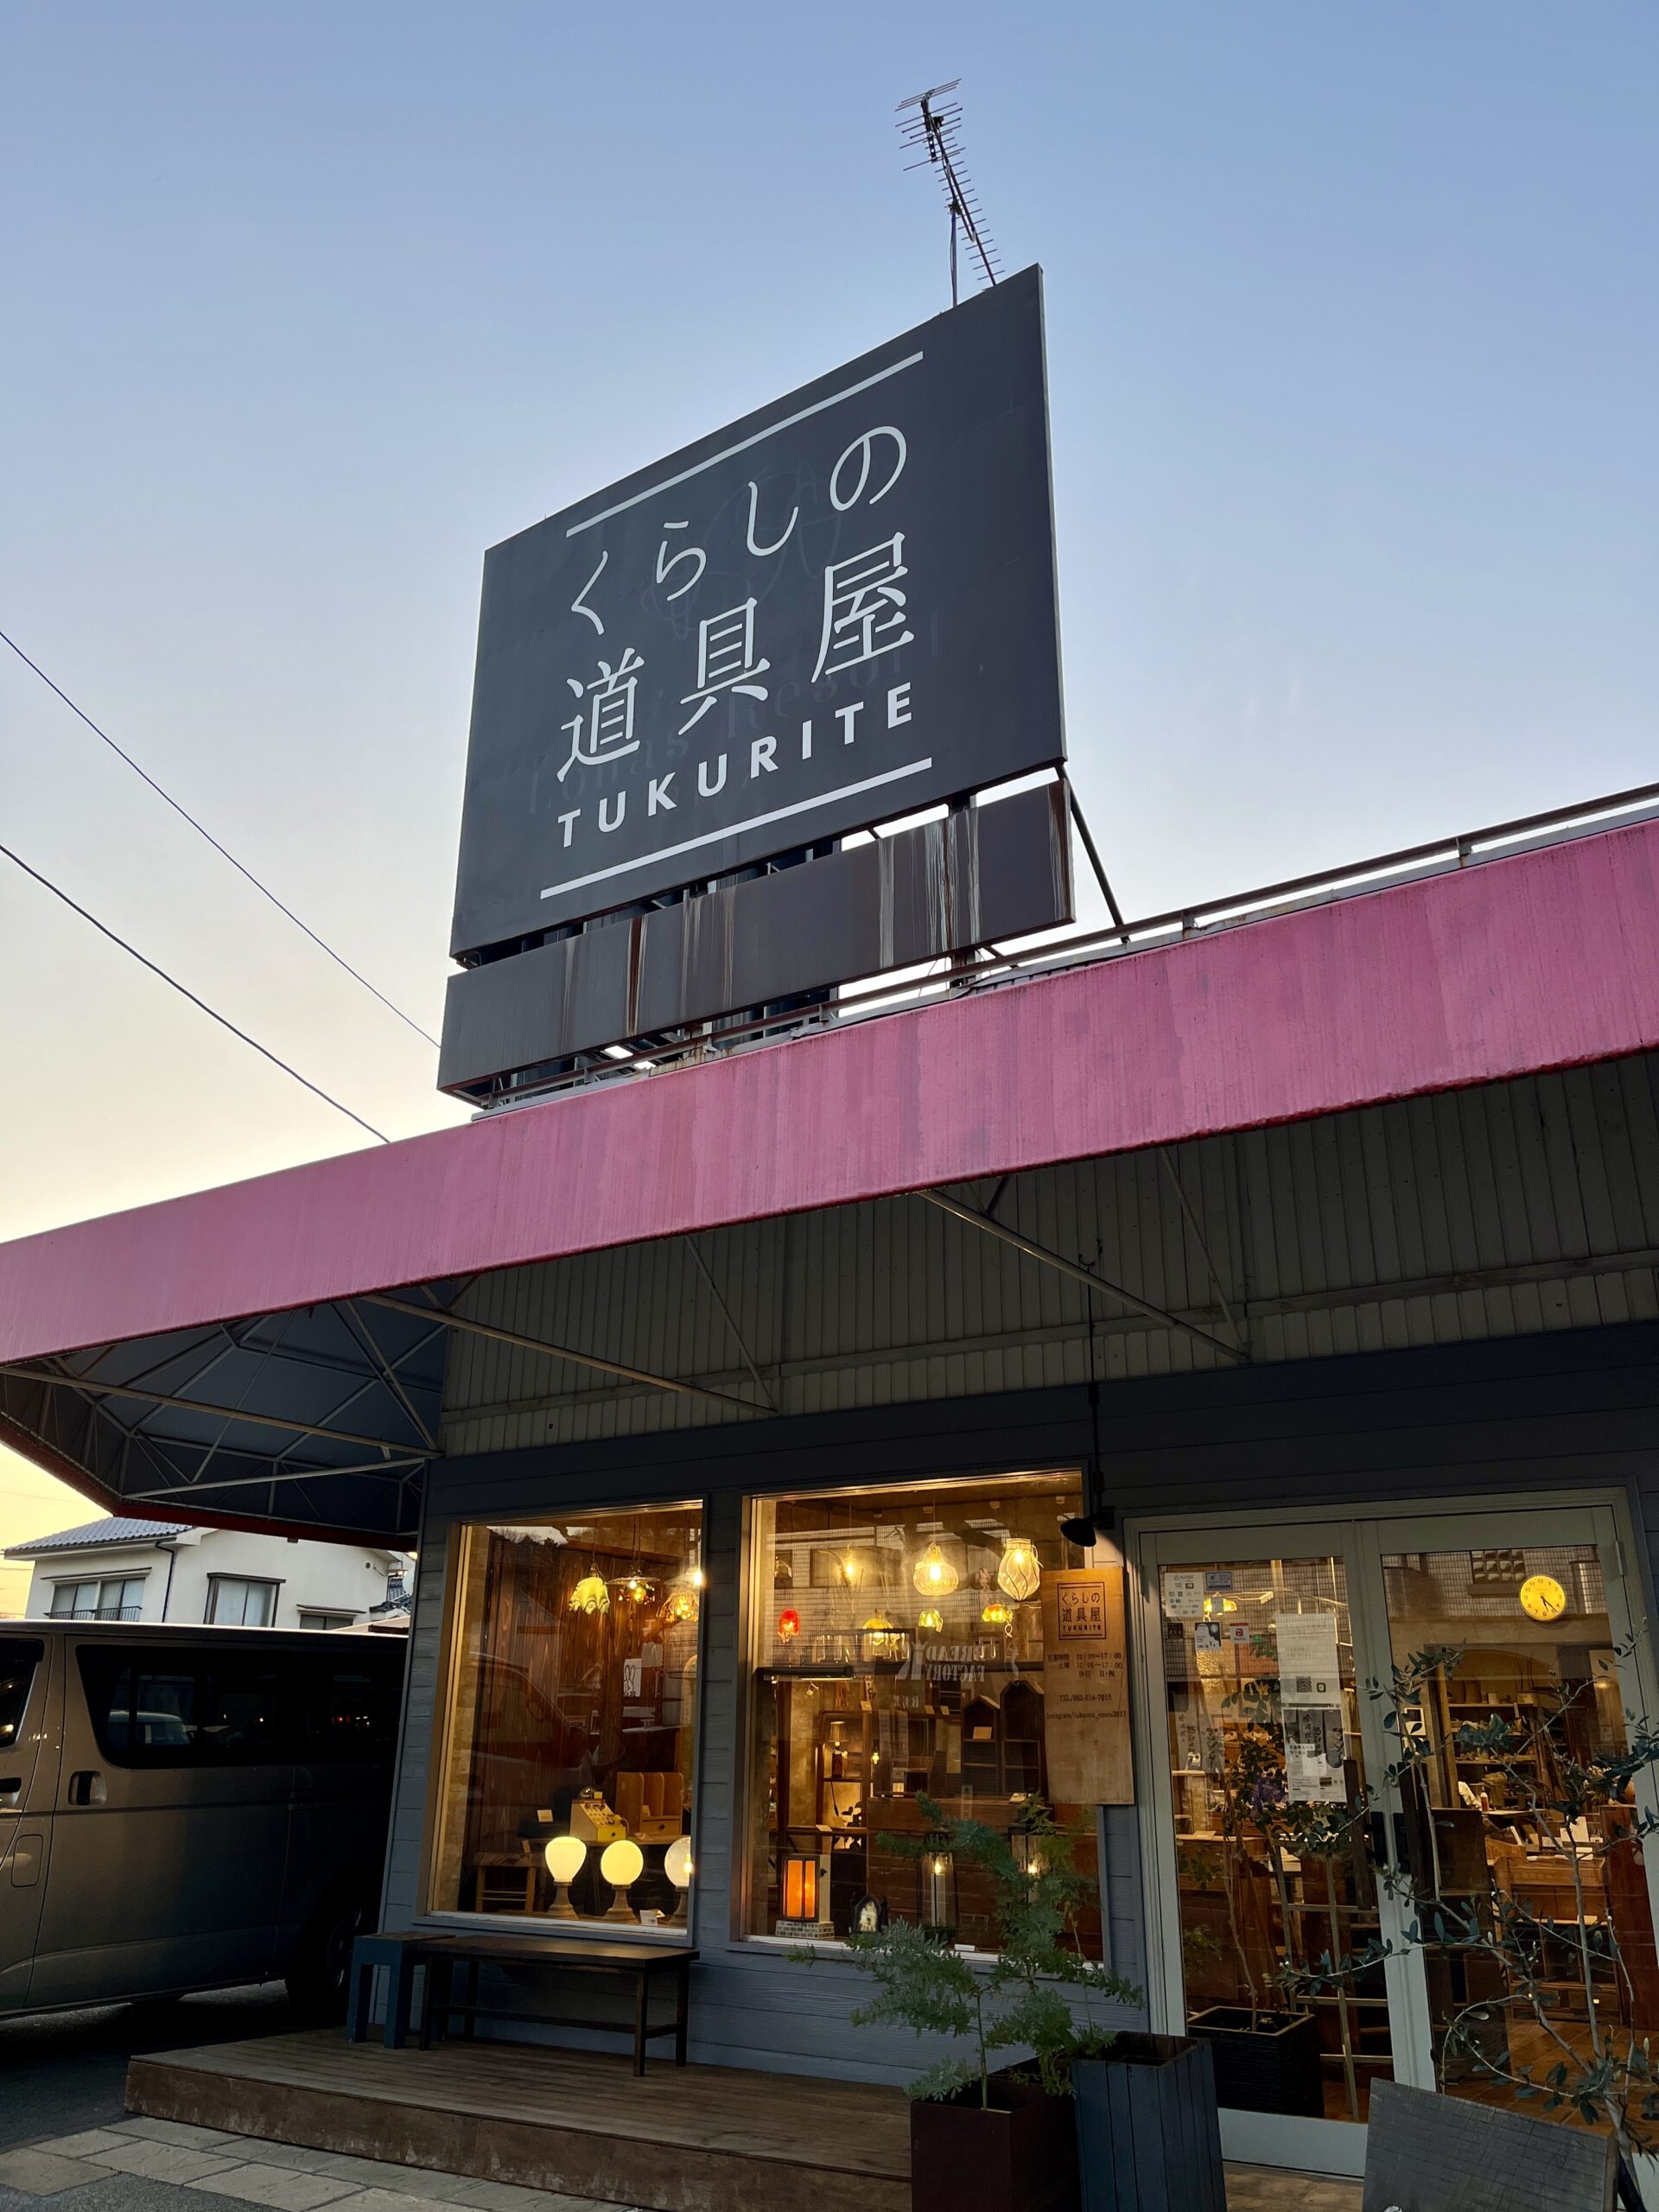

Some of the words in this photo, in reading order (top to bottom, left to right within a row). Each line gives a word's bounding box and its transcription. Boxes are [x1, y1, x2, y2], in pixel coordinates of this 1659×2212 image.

[571, 426, 906, 634] くらしの
[557, 532, 914, 782] 道具屋
[557, 683, 912, 848] TUKURITE
[1062, 1592, 1100, 1605] くらしの
[1062, 1607, 1101, 1622] 道具屋
